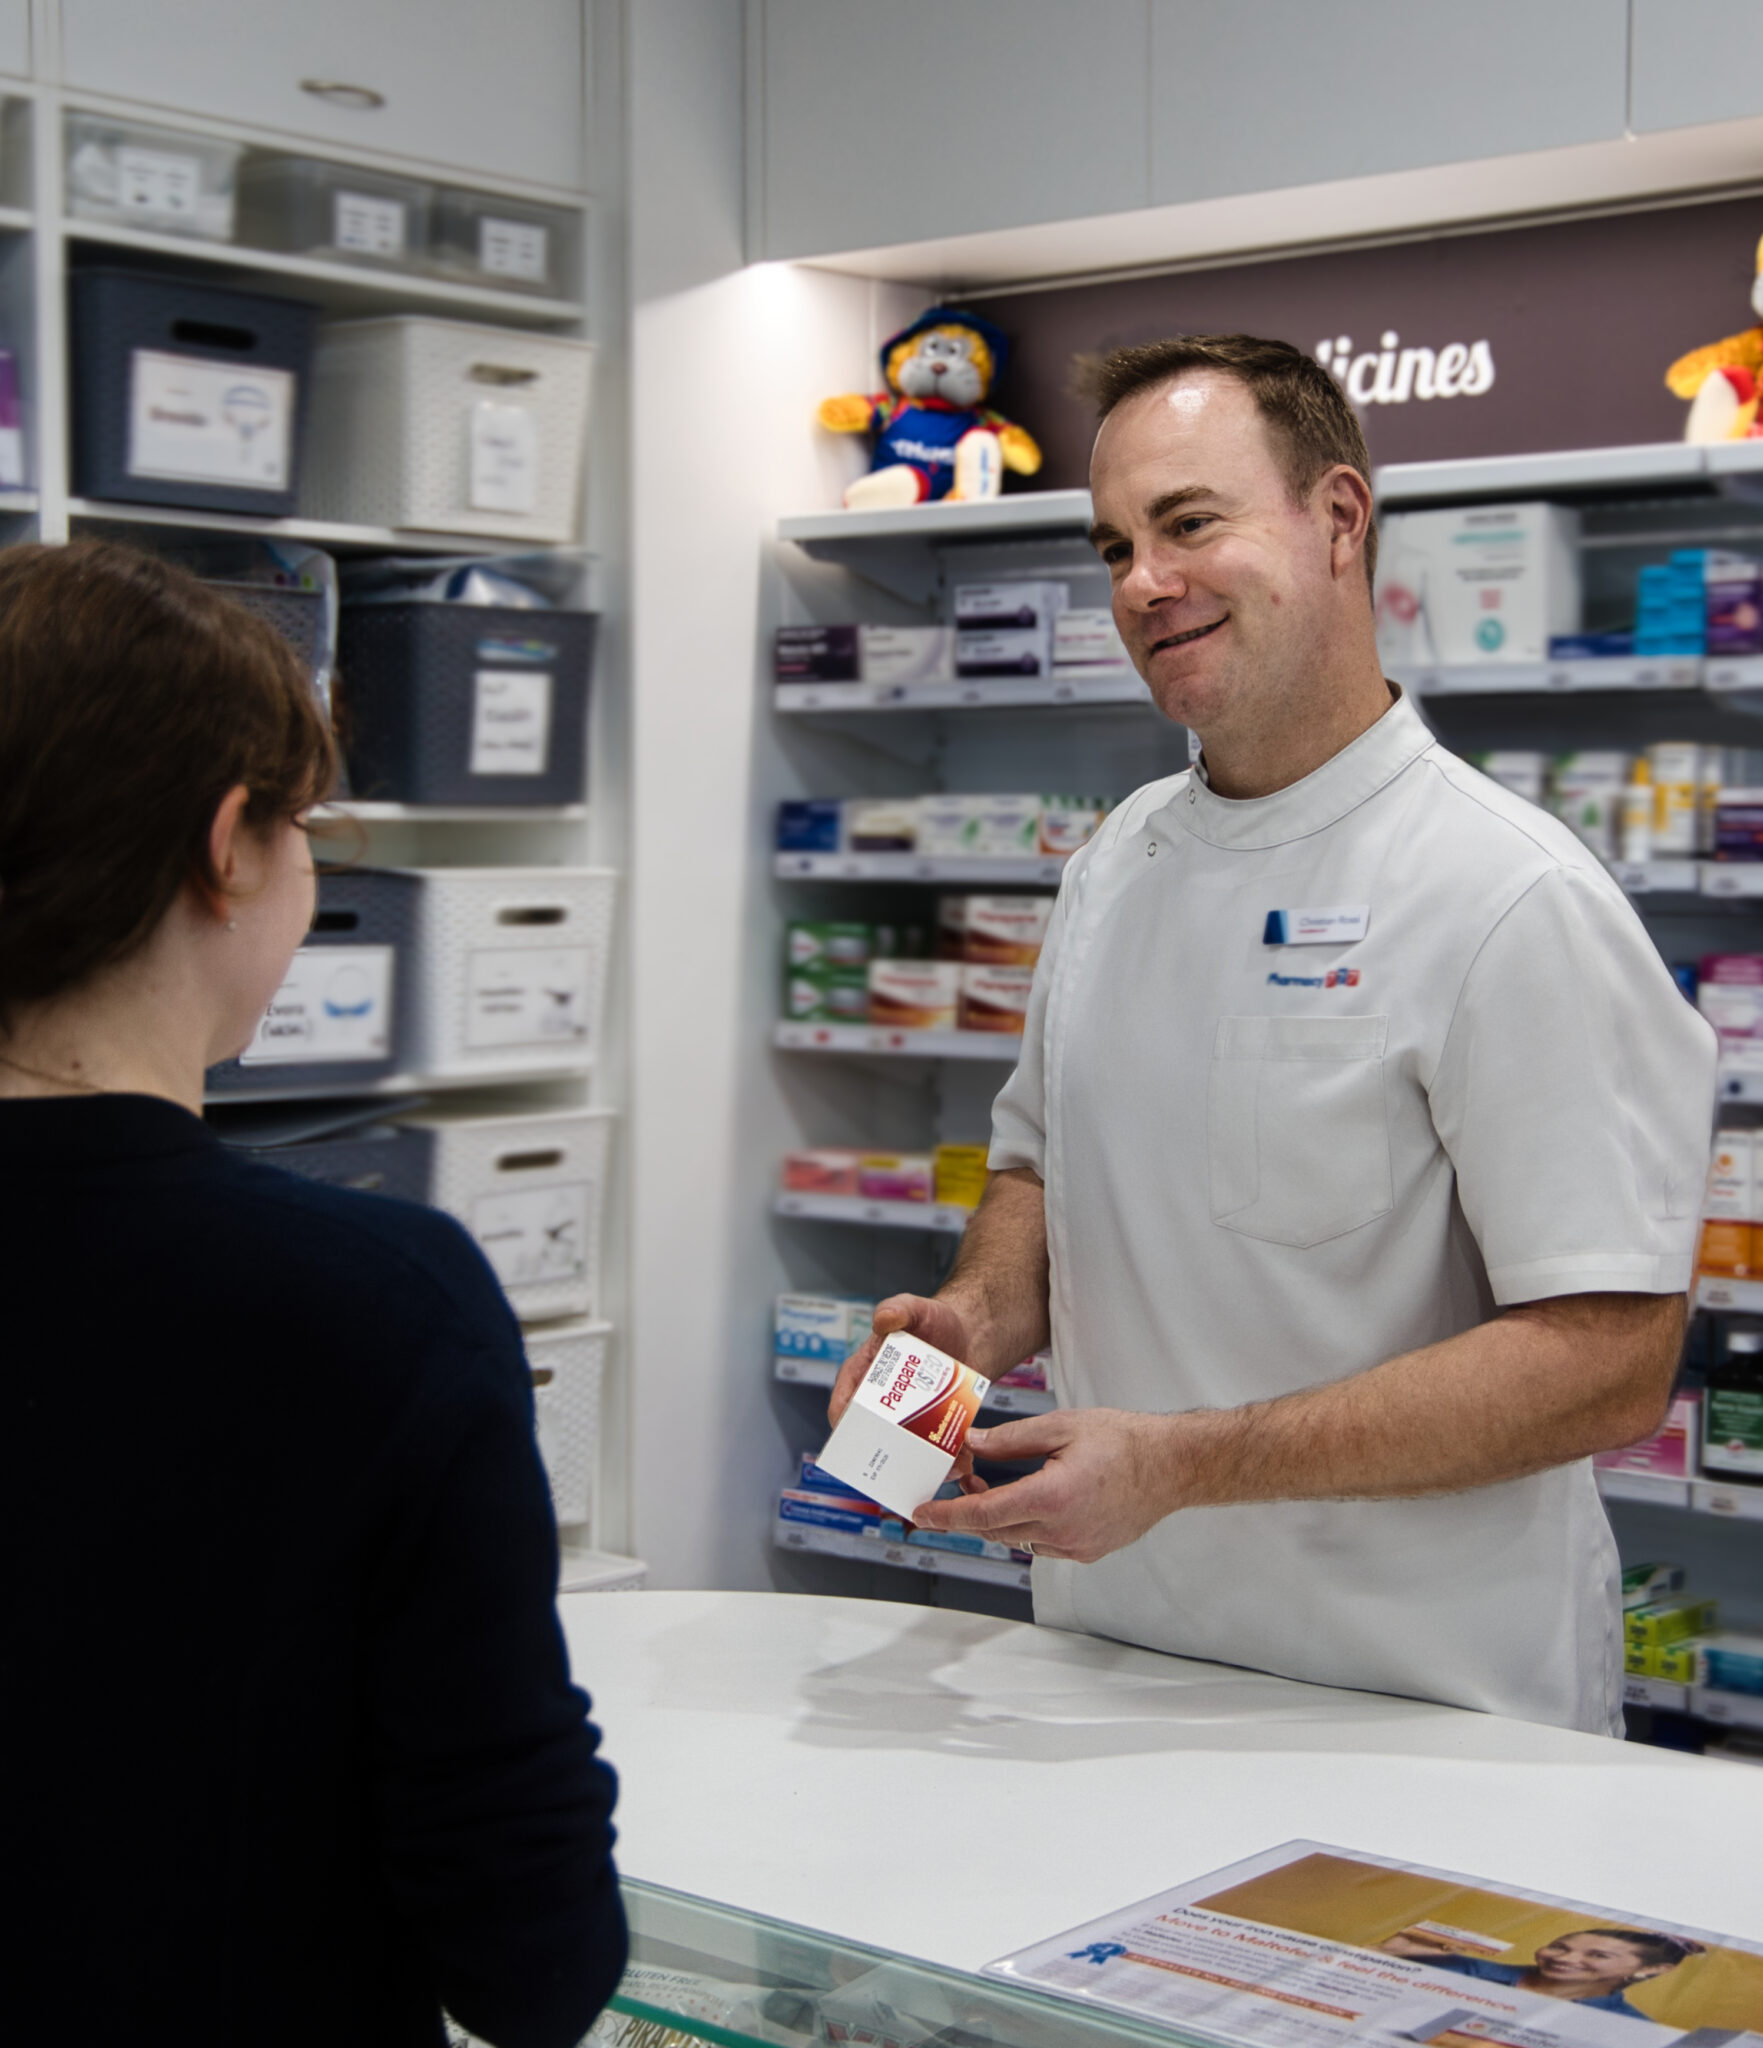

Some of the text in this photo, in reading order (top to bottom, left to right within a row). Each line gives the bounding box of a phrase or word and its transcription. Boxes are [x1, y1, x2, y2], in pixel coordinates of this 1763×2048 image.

[1267, 972, 1324, 988] Pharmacy
[880, 1354, 921, 1411] Parapane
[1156, 1914, 1208, 1932] Move
[1211, 1926, 1230, 1938] to
[1233, 1932, 1313, 1959] Maltofer
[1317, 1953, 1335, 1964] &
[1337, 1959, 1374, 1975] feel
[1376, 1969, 1408, 1985] the
[1173, 1907, 1422, 1974] Does your iron cause constipation?
[622, 1968, 702, 1986] GLUTEN FREE
